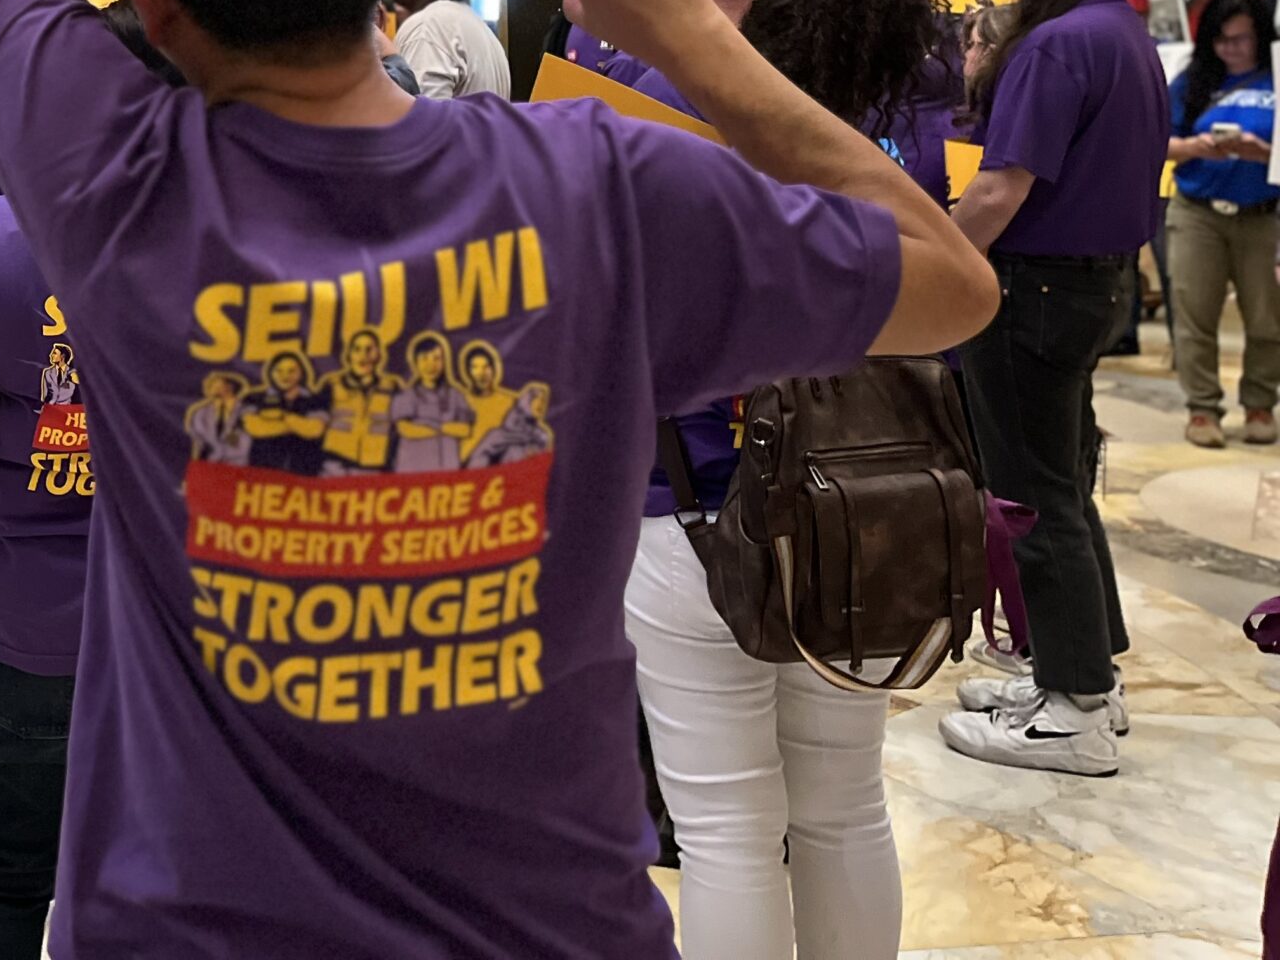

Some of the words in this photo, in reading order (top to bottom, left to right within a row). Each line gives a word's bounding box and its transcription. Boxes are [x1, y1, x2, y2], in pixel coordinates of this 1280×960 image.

[189, 261, 405, 363] SEIU
[435, 226, 549, 332] WI
[194, 516, 372, 565] PROPERTY
[379, 503, 539, 565] SERVICES
[233, 481, 475, 526] HEALTHCARE
[480, 476, 506, 508] &
[190, 557, 541, 644] STRONGER
[193, 629, 543, 723] TOGETHER
